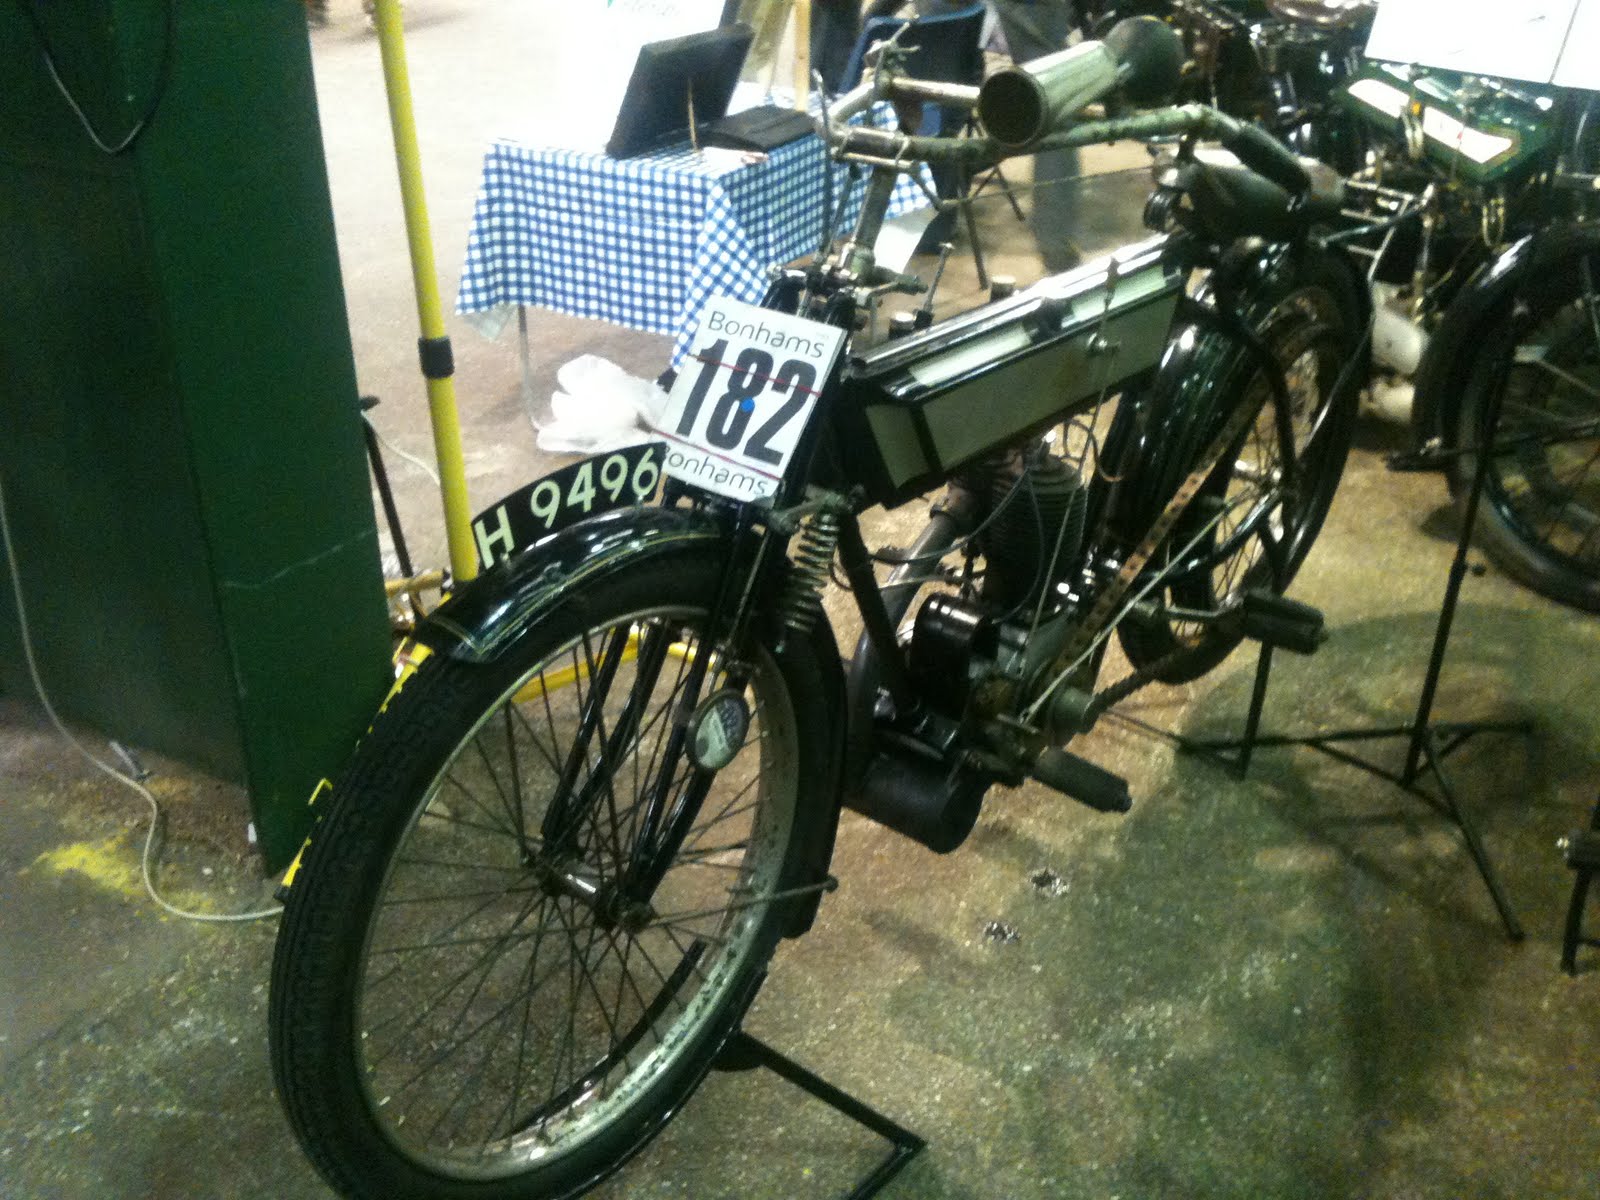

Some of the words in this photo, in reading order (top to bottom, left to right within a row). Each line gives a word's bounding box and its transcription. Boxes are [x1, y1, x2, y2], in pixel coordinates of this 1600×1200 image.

[708, 310, 825, 358] Bonhams
[675, 338, 817, 467] 182
[474, 503, 515, 570] H
[530, 447, 659, 530] 9496
